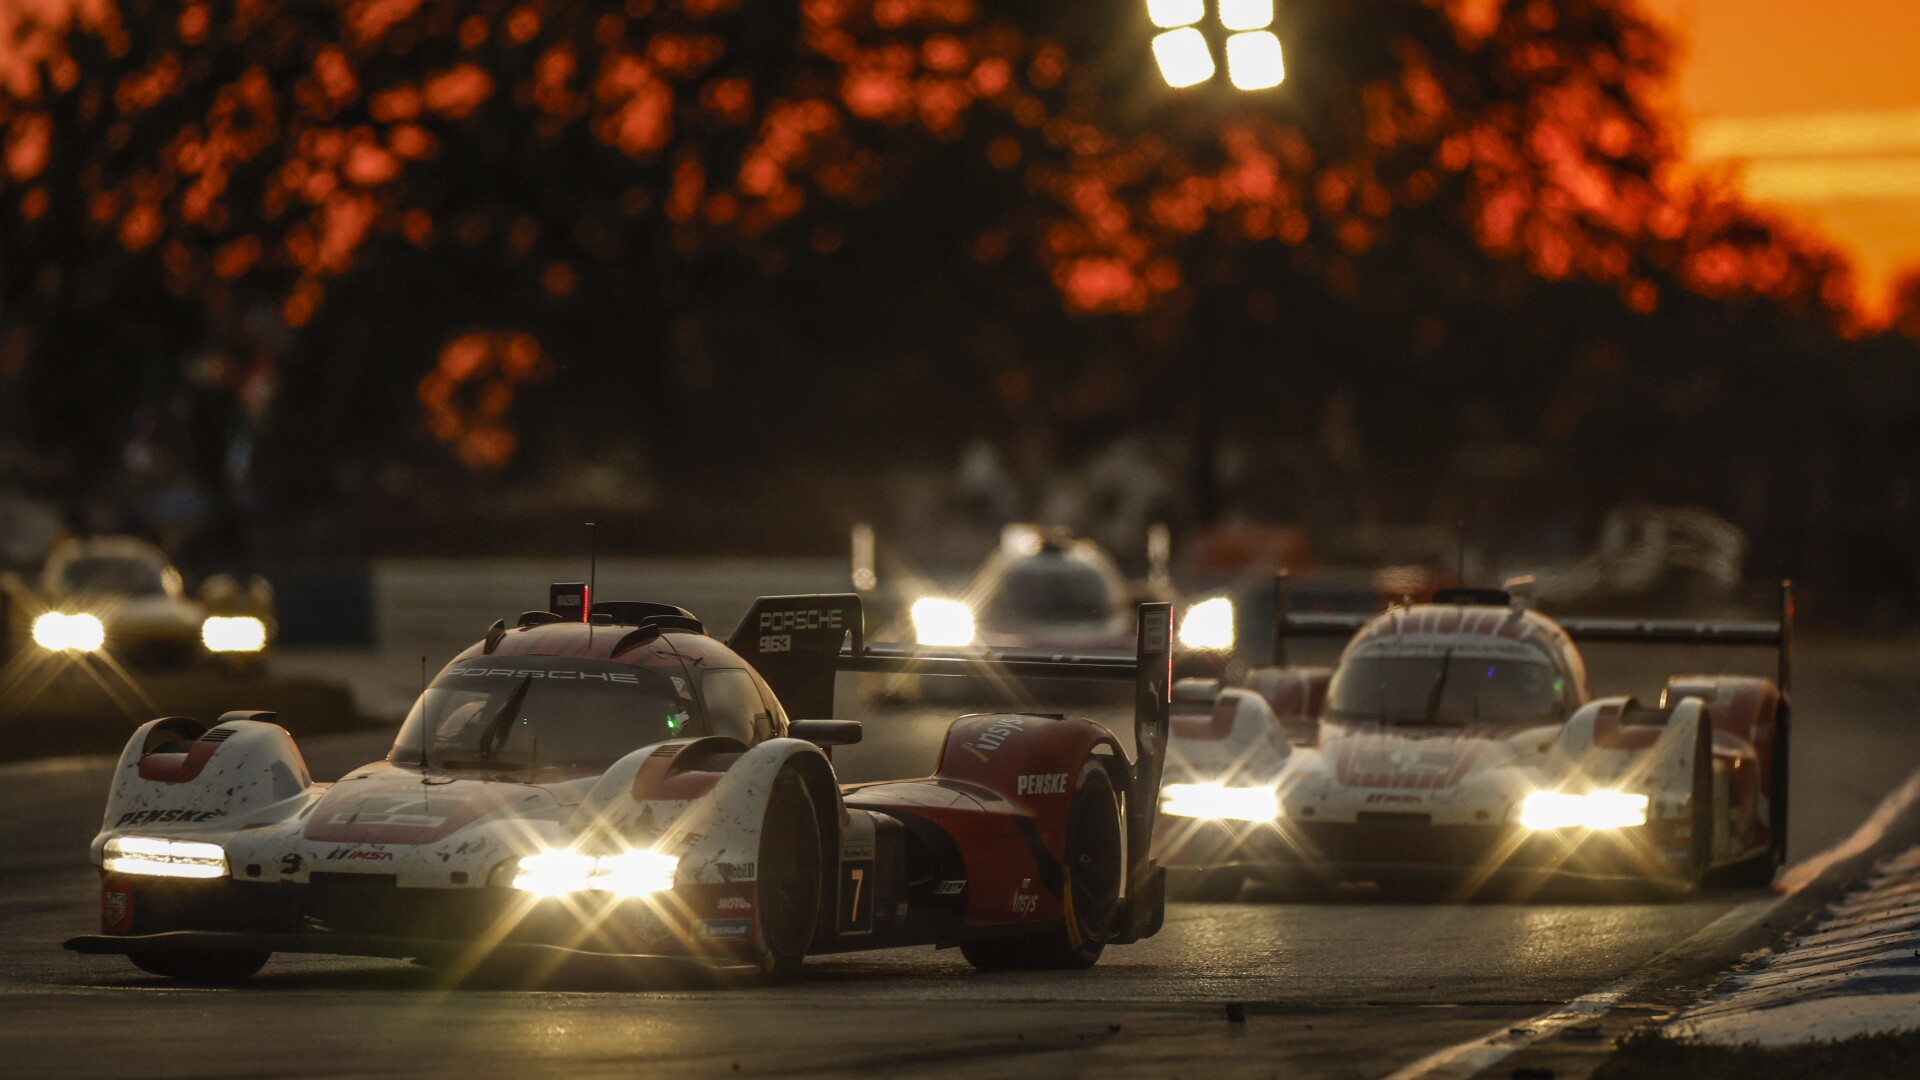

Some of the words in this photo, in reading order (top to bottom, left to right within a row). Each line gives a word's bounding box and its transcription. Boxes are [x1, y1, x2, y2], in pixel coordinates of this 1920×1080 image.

[760, 609, 842, 632] PORSCHE
[760, 635, 791, 653] 963
[447, 668, 640, 685] PORSCHE
[1017, 773, 1069, 796] PENSKE
[114, 809, 219, 828] PENSKE
[851, 869, 864, 922] 7
